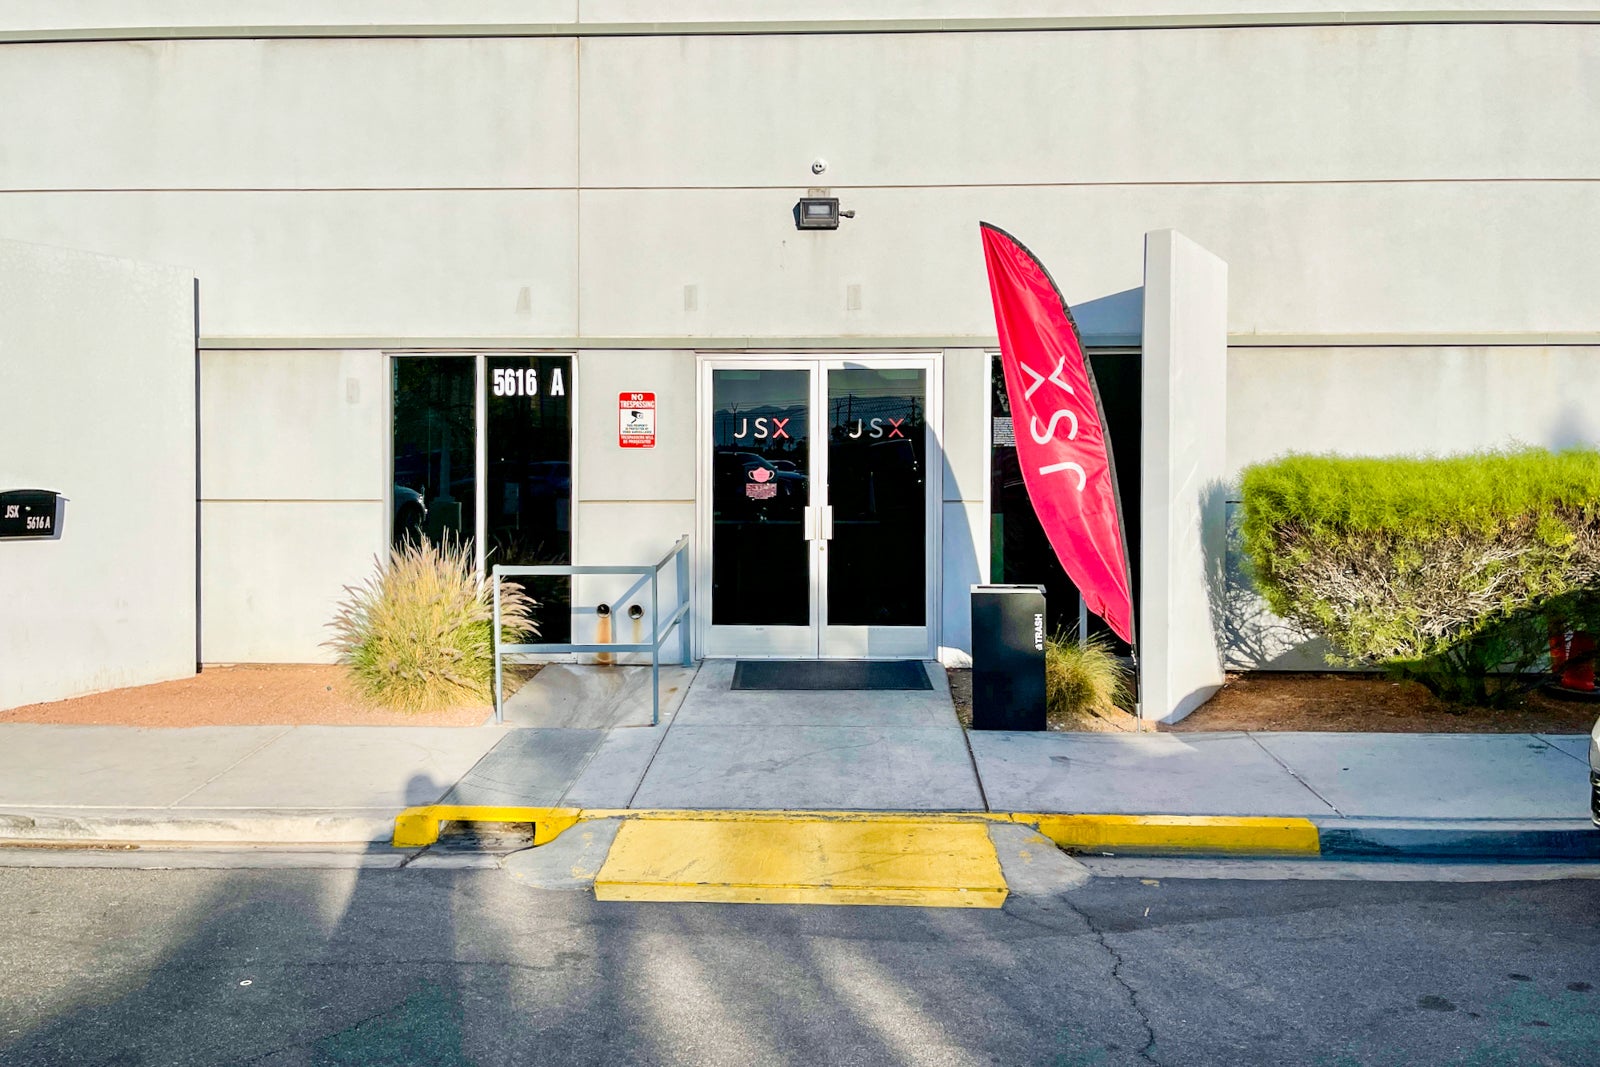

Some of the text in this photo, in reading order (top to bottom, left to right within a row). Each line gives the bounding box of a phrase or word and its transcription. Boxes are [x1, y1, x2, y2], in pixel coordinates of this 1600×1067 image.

[493, 368, 565, 396] 5616 A
[620, 400, 655, 408] TRESPASSING
[734, 417, 789, 438] JSX
[849, 417, 905, 438] JSX
[1020, 354, 1086, 492] JSX
[4, 505, 20, 518] JSX
[26, 516, 51, 529] 5616 A
[1034, 613, 1043, 644] TRASH
